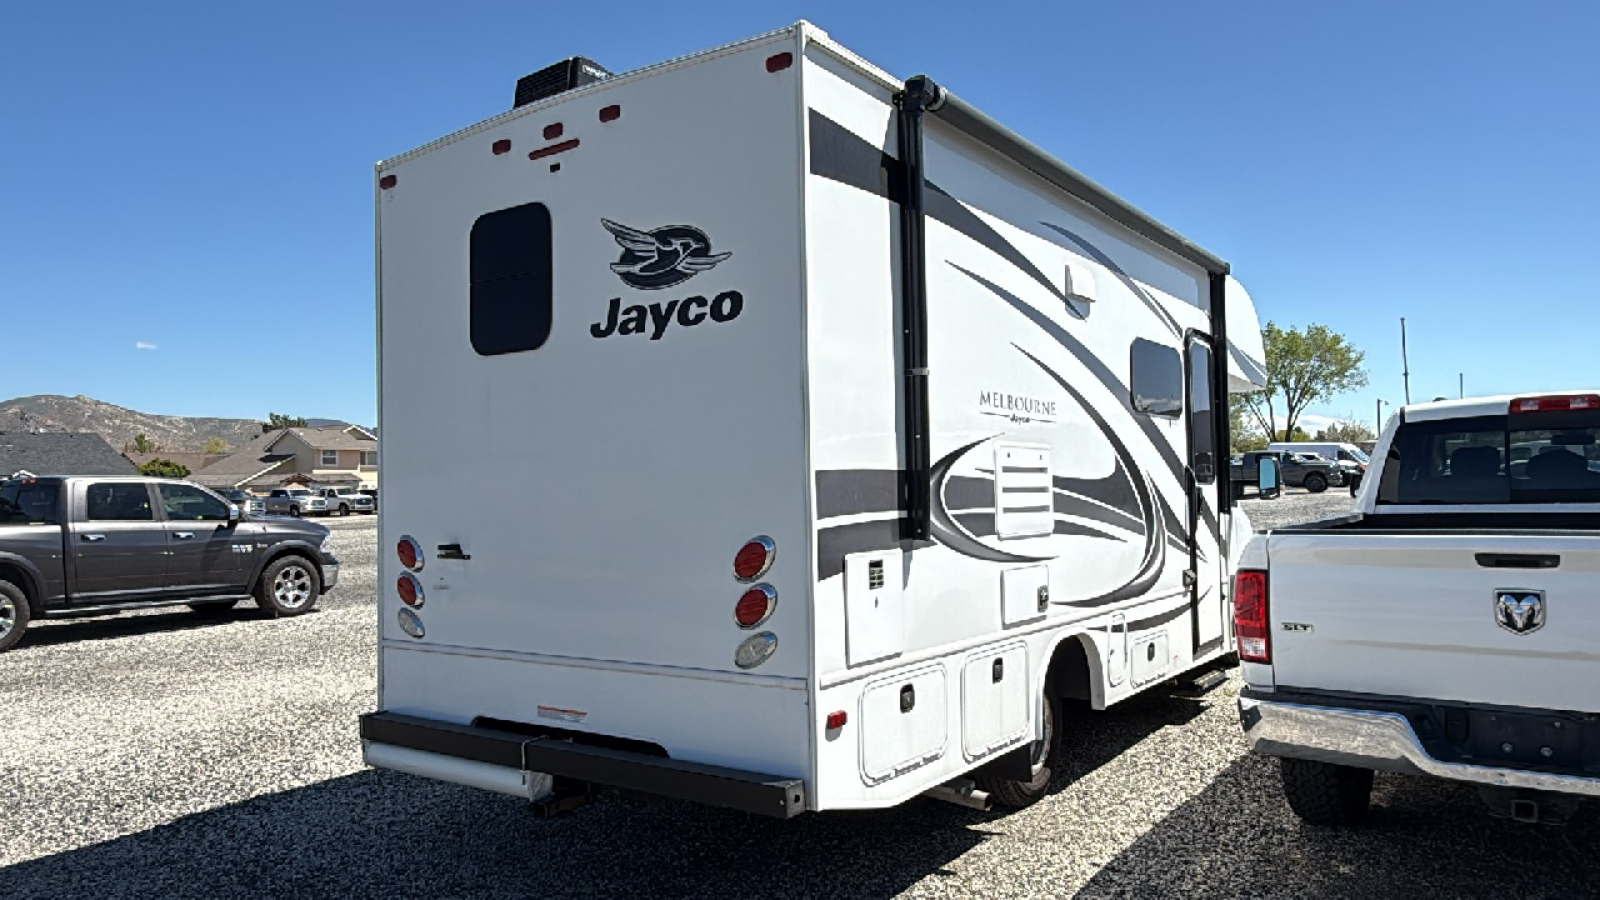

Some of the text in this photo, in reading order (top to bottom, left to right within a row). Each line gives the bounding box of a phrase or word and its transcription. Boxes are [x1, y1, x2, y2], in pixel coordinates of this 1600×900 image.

[590, 290, 743, 340] Jayco
[979, 390, 1057, 416] MELBOURNE
[1281, 621, 1312, 632] SLT
